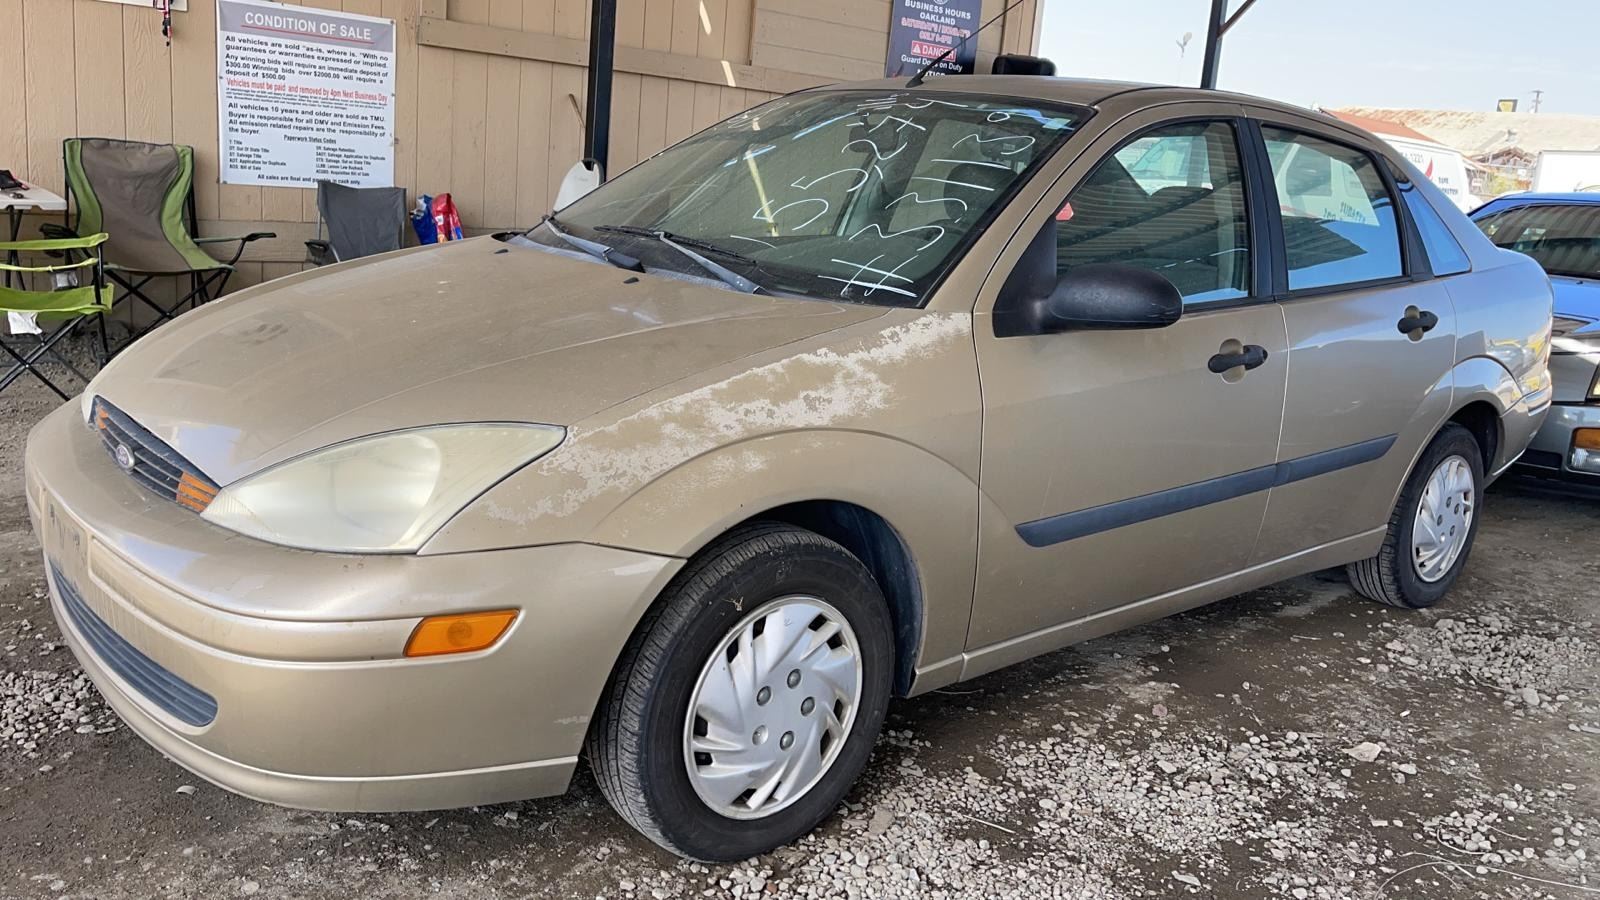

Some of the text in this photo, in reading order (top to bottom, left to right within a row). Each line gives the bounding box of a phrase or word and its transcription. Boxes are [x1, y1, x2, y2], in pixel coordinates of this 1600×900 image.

[905, 0, 971, 19] BUSINESS HOURS
[245, 12, 371, 40] CONDITION OF SALE
[920, 12, 956, 25] OAKLAND
[238, 37, 268, 47] vehicles
[284, 43, 300, 51] sold
[922, 45, 954, 60] DANGR
[225, 44, 267, 54] guarantees
[278, 50, 315, 60] warranties
[316, 55, 352, 64] expressed
[362, 60, 388, 68] implied.
[901, 55, 921, 64] Guard
[948, 63, 963, 72] Duty
[225, 53, 238, 61] Any
[240, 55, 266, 64] winning
[295, 62, 317, 70] require
[327, 66, 357, 74] immediate
[359, 69, 380, 77] deposit
[225, 60, 250, 69] $300.00
[252, 64, 278, 73] Winning
[313, 70, 340, 79] $2000.00
[356, 76, 377, 84] require
[225, 69, 250, 77] deposit
[261, 72, 286, 80] $500.00
[226, 77, 250, 87] Vehicles
[251, 81, 265, 89] must
[266, 82, 273, 90] be
[274, 83, 286, 92] paid
[288, 84, 298, 93] and
[299, 87, 322, 95] removed
[323, 88, 329, 98] by
[355, 91, 377, 100] Business
[378, 93, 388, 104] Day
[240, 104, 269, 112] vehicles
[238, 120, 268, 128] emission
[269, 122, 291, 130] related
[292, 124, 314, 132] repairs
[339, 129, 378, 138] responsibility
[257, 114, 293, 123] responsible
[343, 121, 370, 129] Emission
